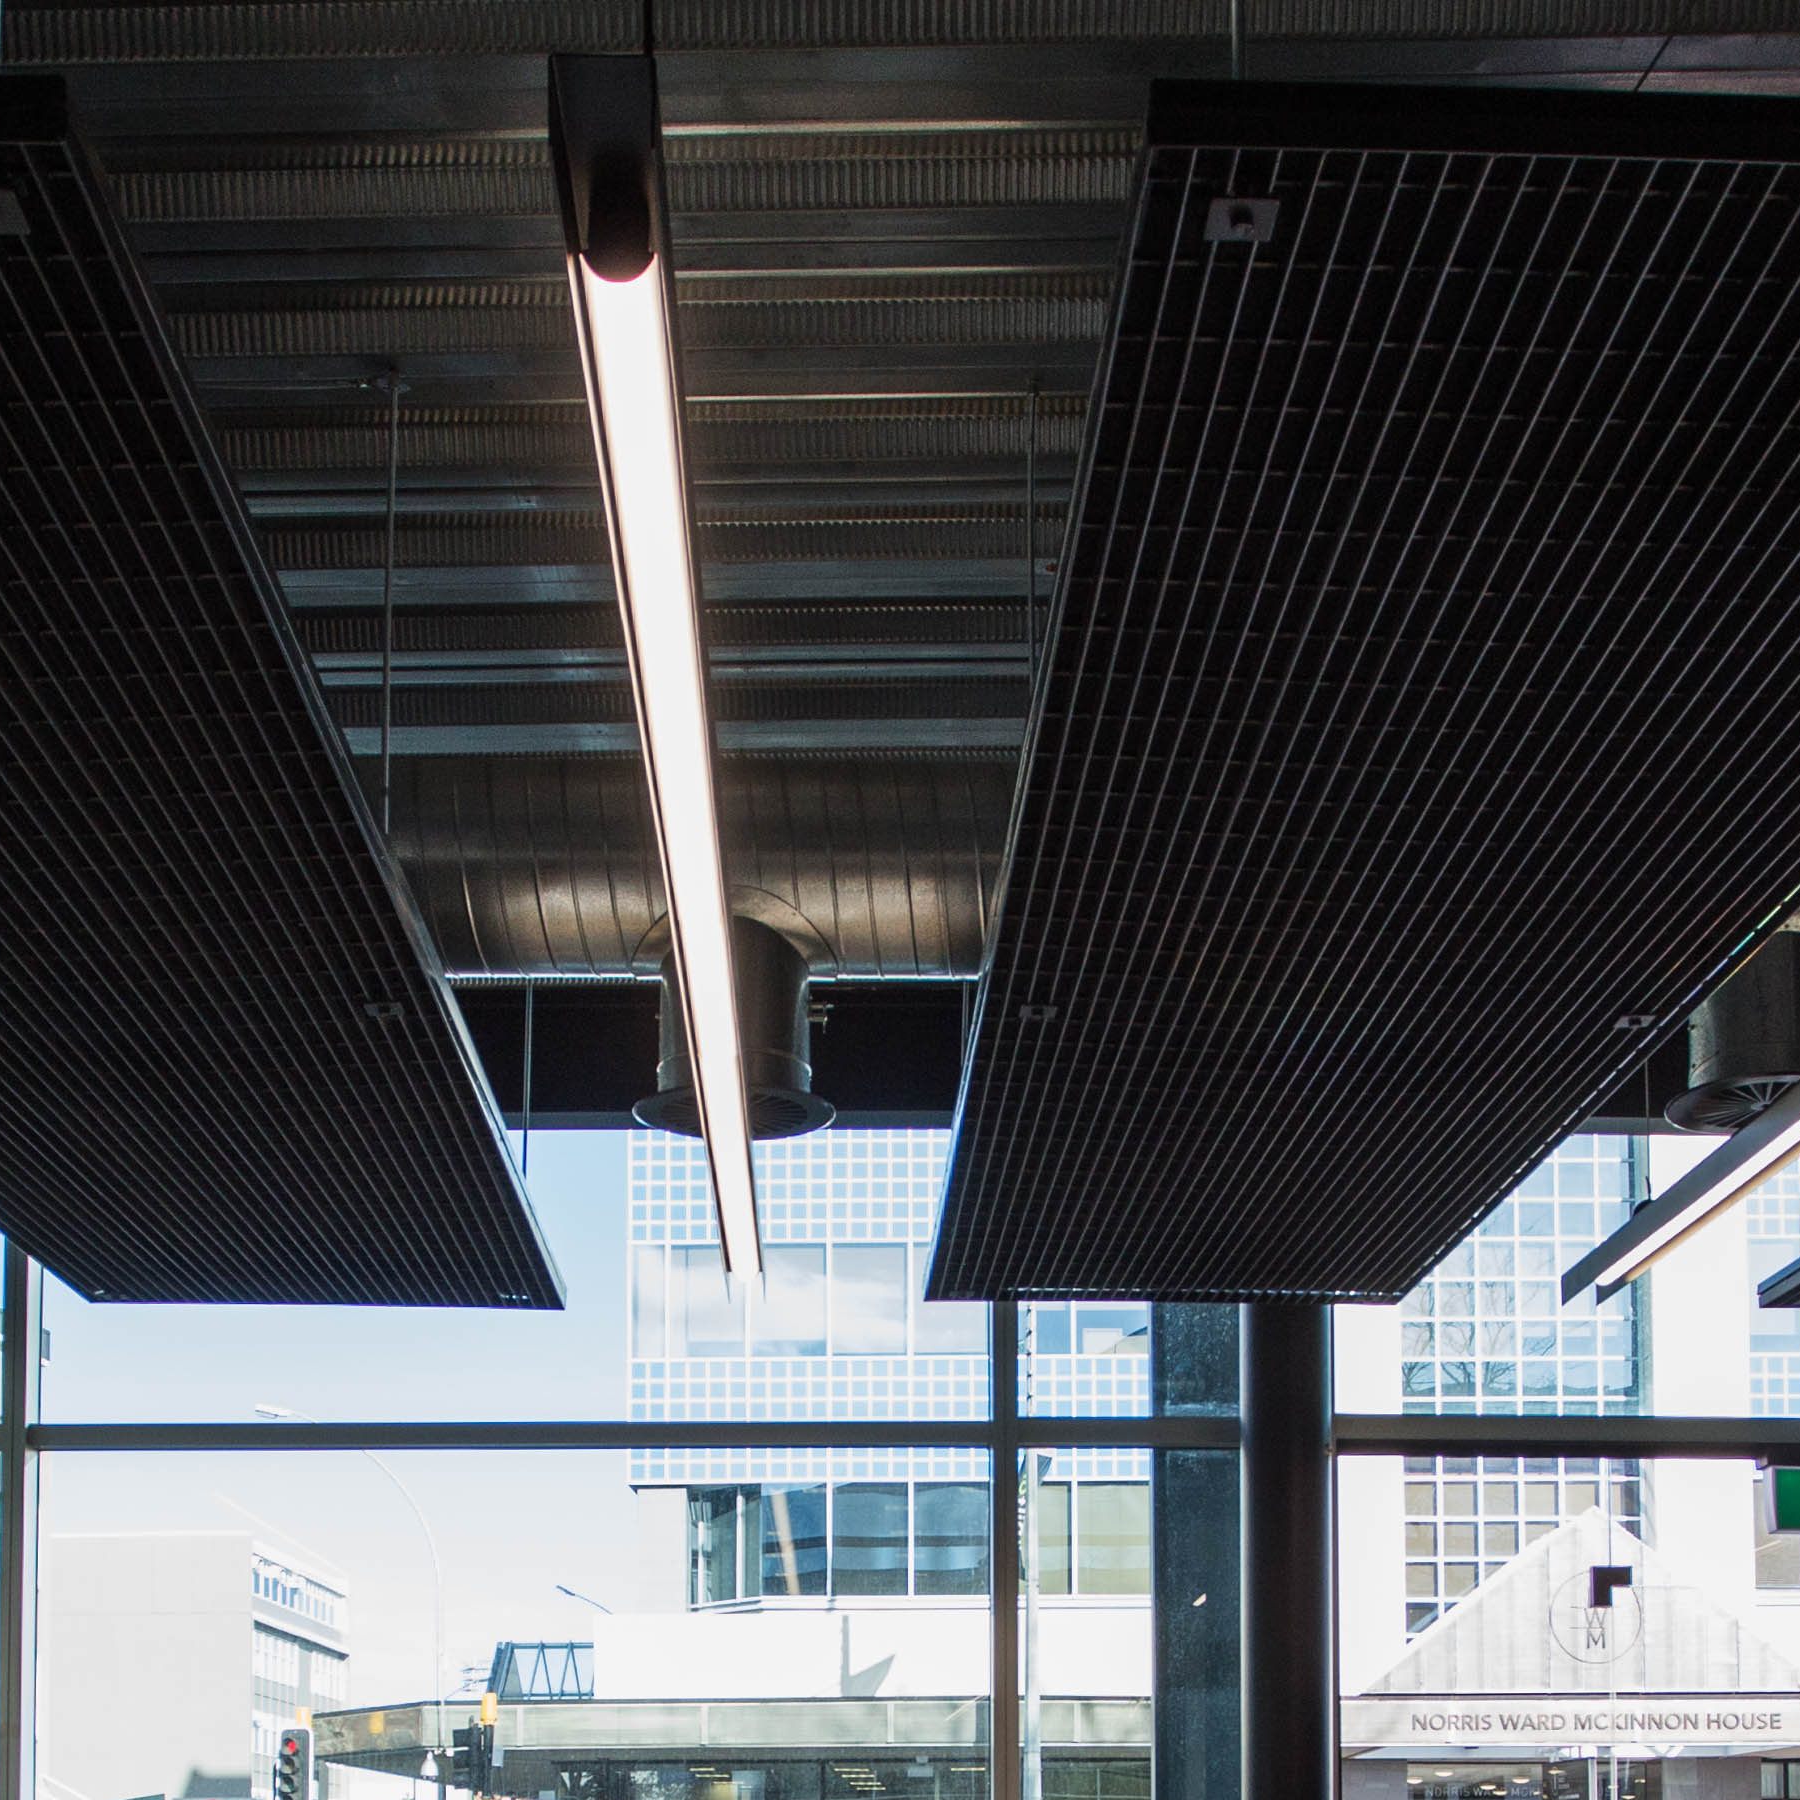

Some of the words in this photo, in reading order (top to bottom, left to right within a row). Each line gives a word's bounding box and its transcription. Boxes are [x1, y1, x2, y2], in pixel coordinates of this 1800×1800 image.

[1411, 1713, 1492, 1732] NORRIS
[1499, 1713, 1565, 1731] WARD
[1706, 1712, 1782, 1730] HOUSE
